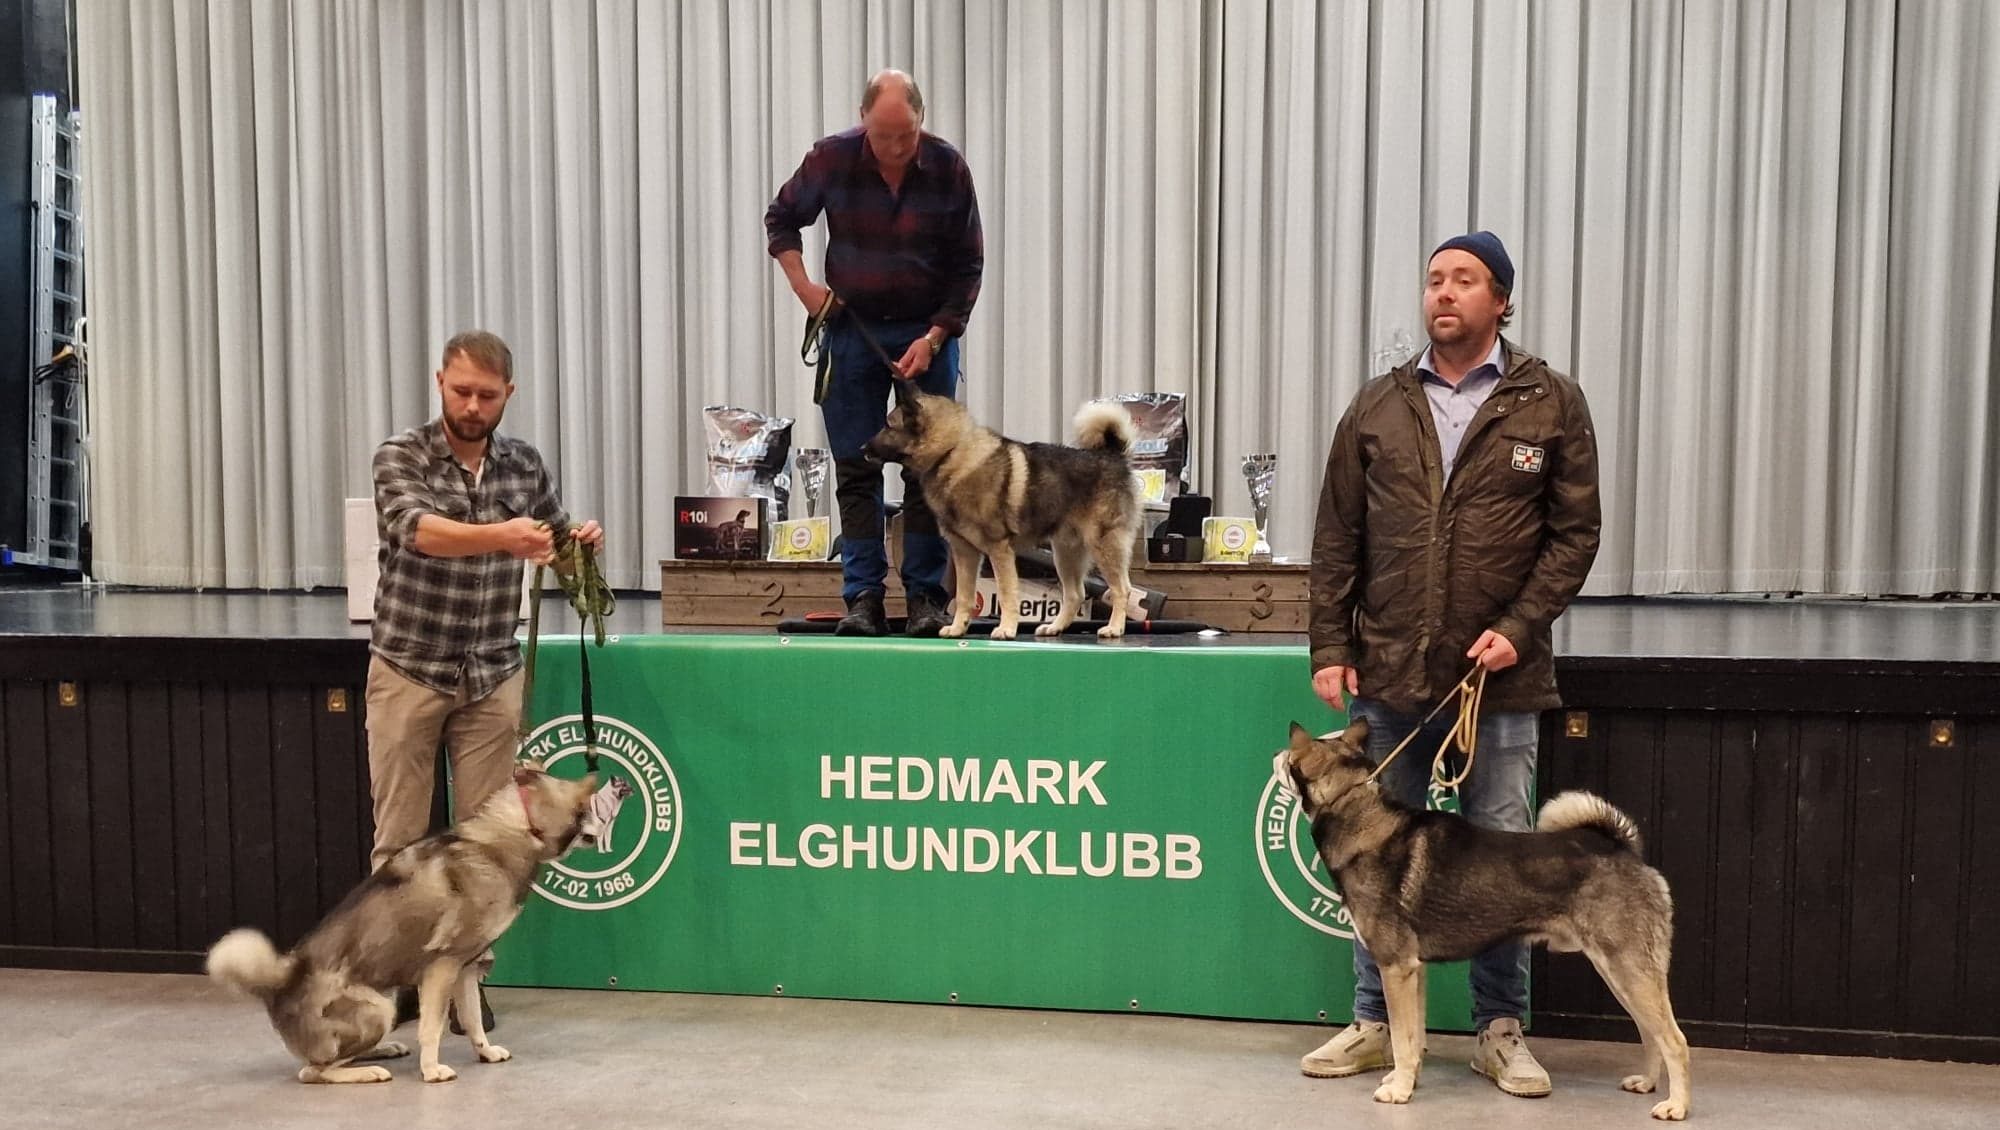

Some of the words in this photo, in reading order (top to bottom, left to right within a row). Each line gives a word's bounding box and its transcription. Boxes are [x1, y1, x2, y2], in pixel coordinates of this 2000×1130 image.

[680, 510, 708, 524] R10i
[760, 582, 785, 617] 2
[990, 593, 1084, 621] Ierja
[1250, 580, 1274, 620] 3
[557, 725, 672, 832] ELHUNDKLUBB
[820, 755, 1108, 806] HEDMARK
[1268, 785, 1298, 850] HEDM
[729, 822, 1203, 880] ELGHUNDKLUBB
[544, 870, 589, 898] 17-02
[594, 872, 635, 898] 1968
